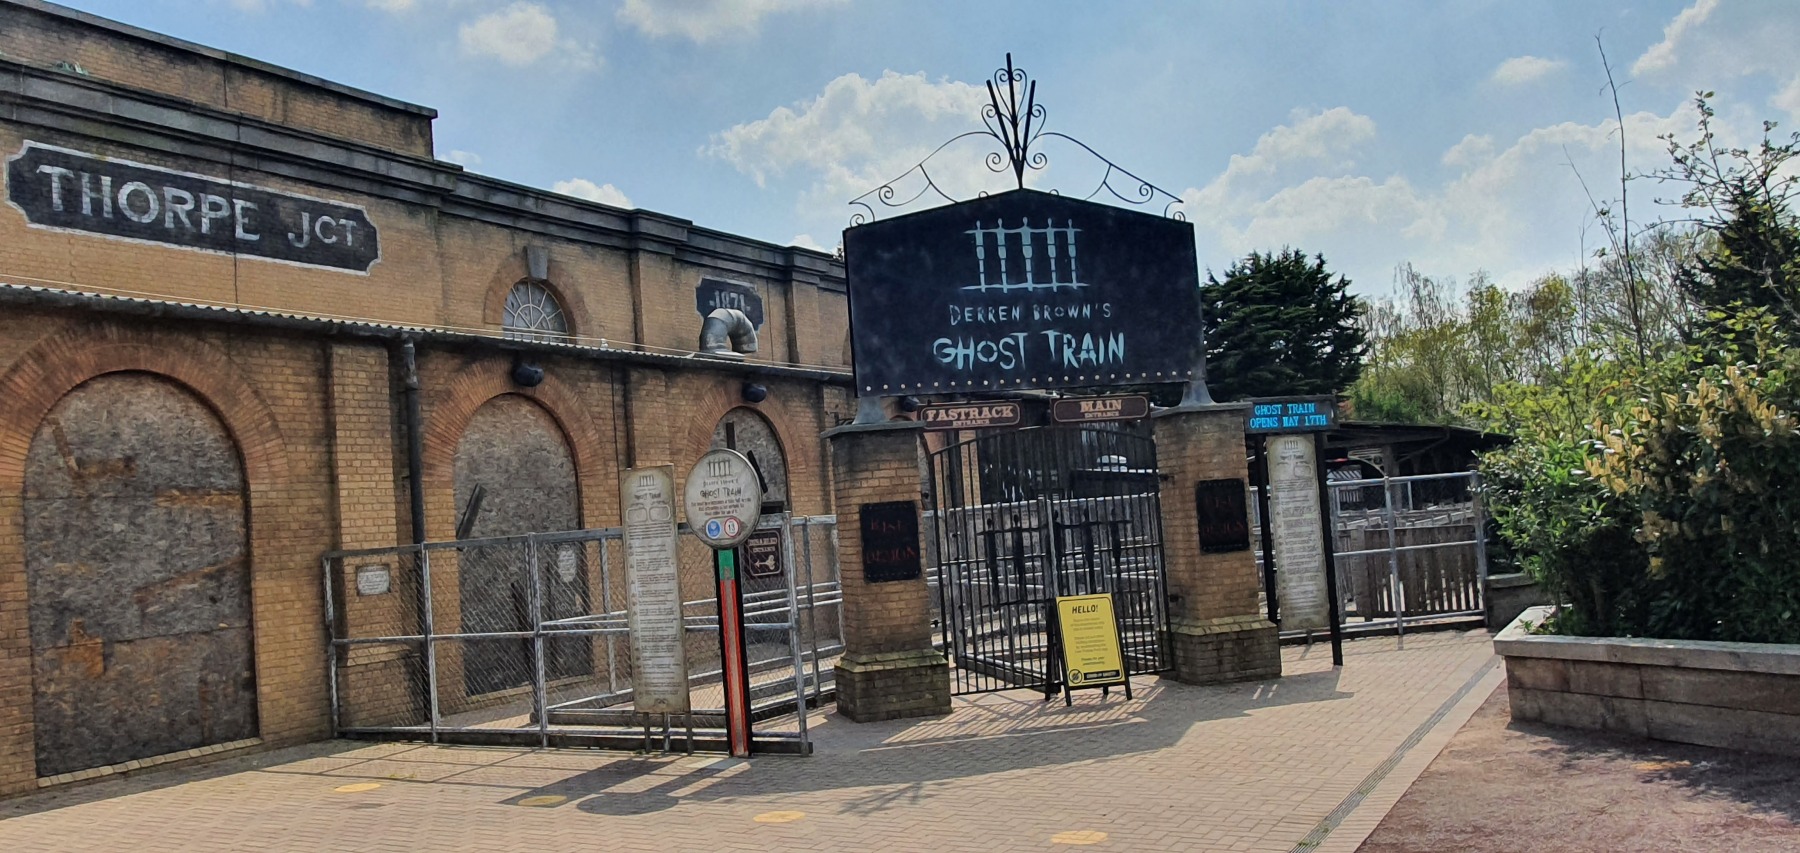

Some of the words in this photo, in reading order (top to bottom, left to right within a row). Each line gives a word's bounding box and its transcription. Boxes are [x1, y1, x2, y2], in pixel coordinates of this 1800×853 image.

[36, 164, 261, 241] THORPE
[287, 211, 357, 248] JCT
[949, 304, 1021, 325] DERREN
[1033, 302, 1112, 321] BROWN'S
[932, 332, 1028, 371] GHOST
[1040, 329, 1125, 369] TRAIN
[926, 404, 1014, 422] FASTRACK
[1079, 400, 1123, 413] MAIN
[1254, 404, 1282, 416] GHOST
[1287, 403, 1315, 415] TRAIN
[952, 419, 991, 428] ENTRANCE
[1249, 417, 1279, 428] OPENS
[1282, 416, 1299, 427] MAY
[1305, 415, 1328, 426] 17TH
[700, 488, 720, 499] GHOST
[1072, 604, 1098, 614] HELLO!
